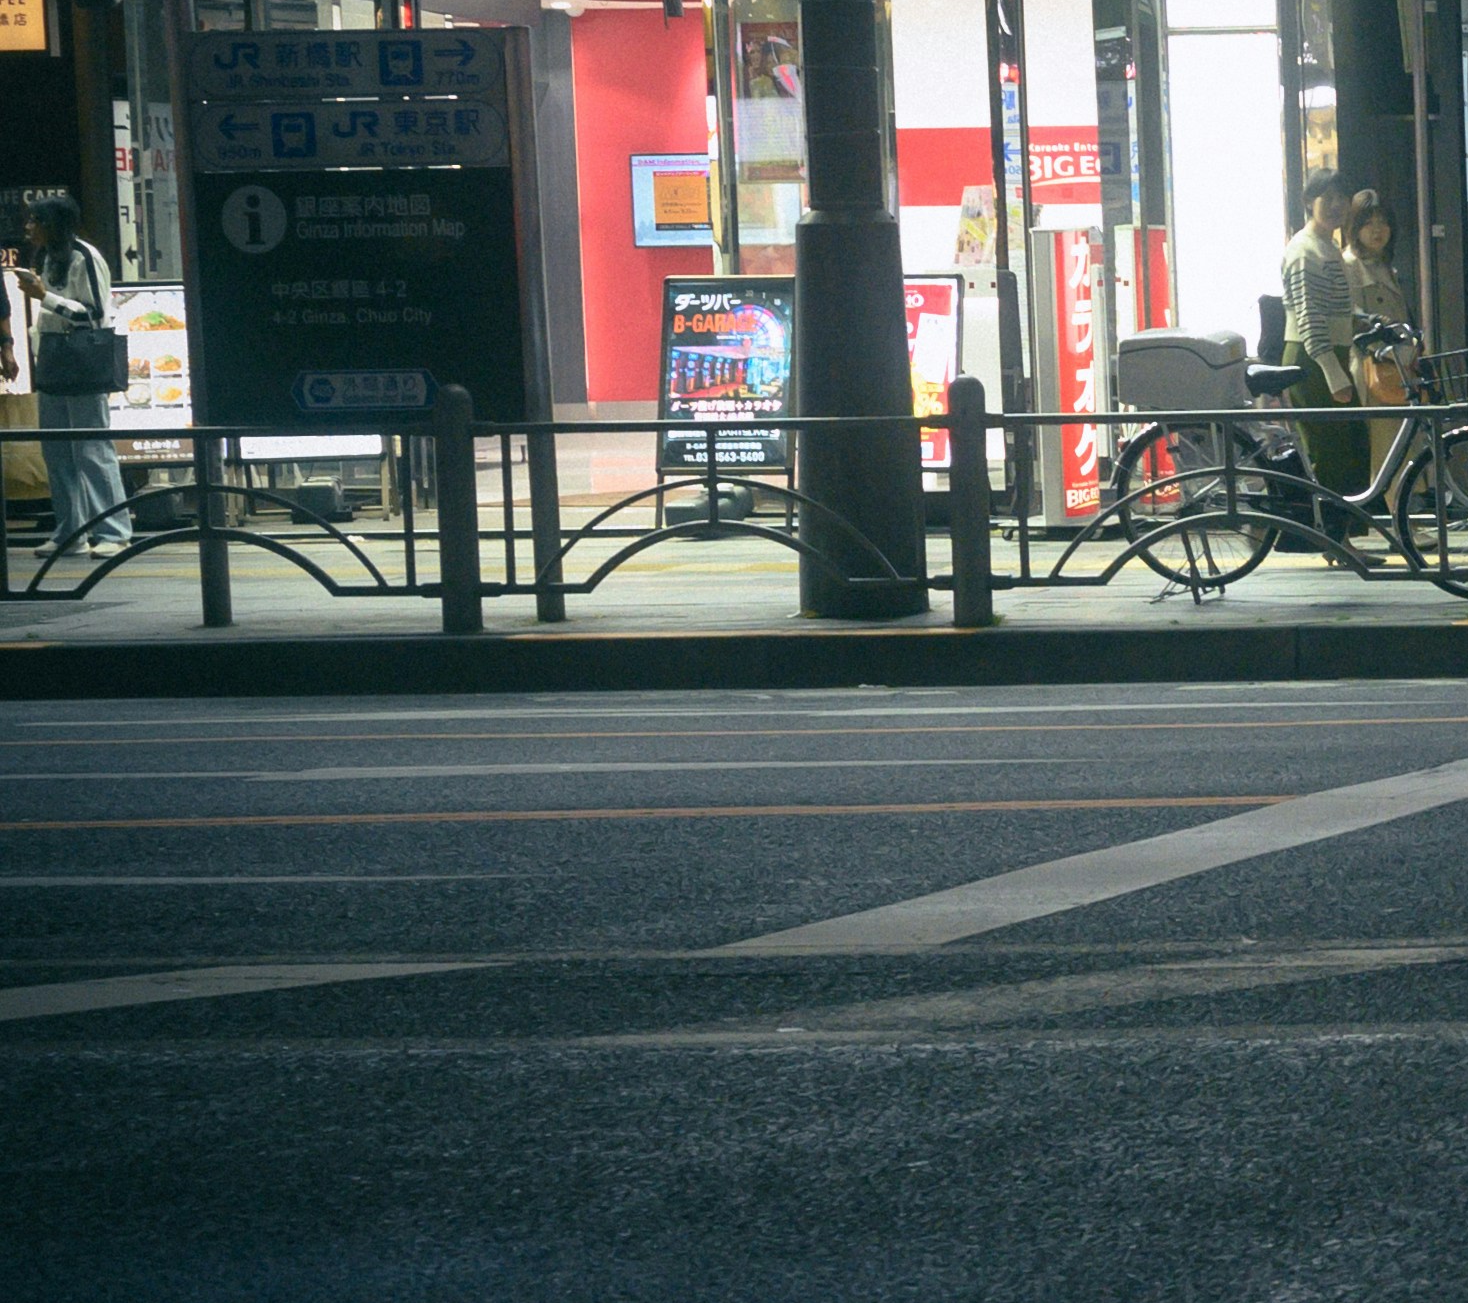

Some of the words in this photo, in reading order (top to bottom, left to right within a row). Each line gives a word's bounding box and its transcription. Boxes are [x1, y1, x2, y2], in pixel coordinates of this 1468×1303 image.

[214, 42, 261, 69] JR
[276, 41, 363, 68] 新橋駅
[333, 110, 379, 138] JR
[394, 109, 481, 136] 東京駅
[296, 194, 431, 217] 銀座案内地図
[296, 221, 339, 239] Ginza
[343, 220, 428, 238] Information
[432, 218, 466, 240] Map
[675, 294, 741, 311] ダーツバー
[403, 307, 432, 326] City
[673, 313, 758, 334] B-GARAGE
